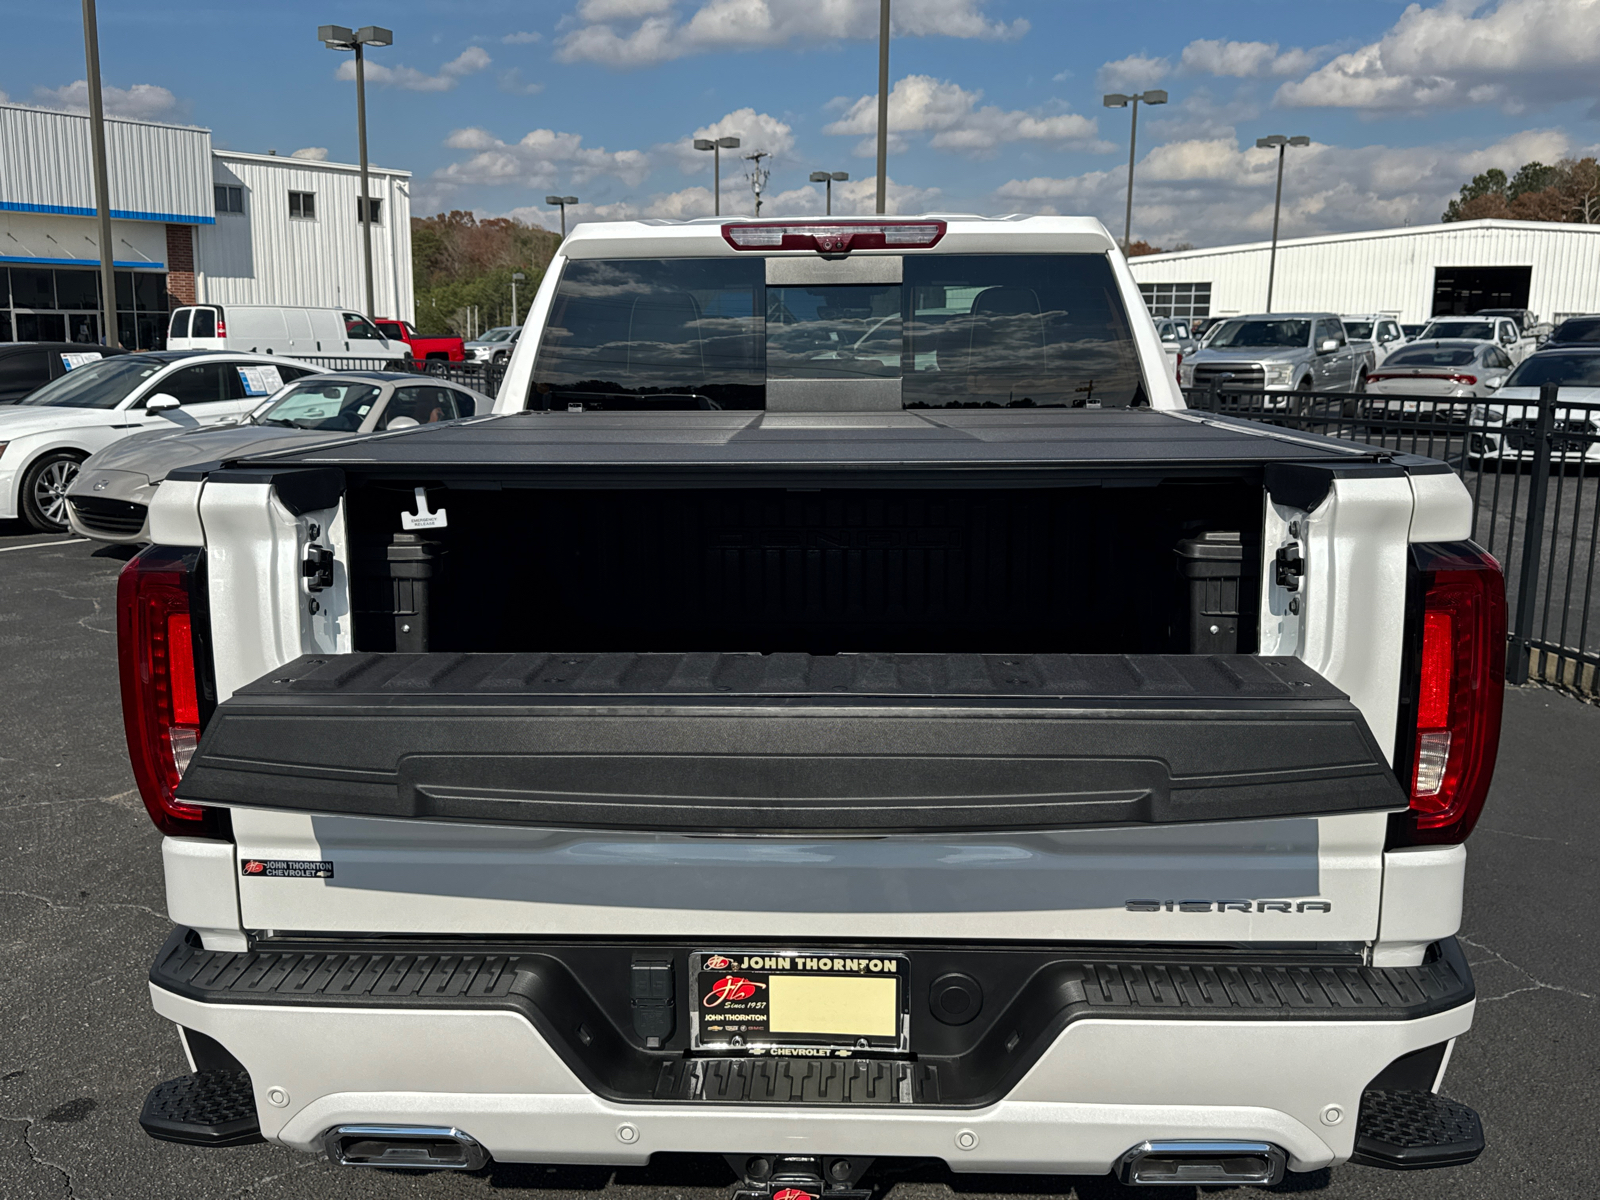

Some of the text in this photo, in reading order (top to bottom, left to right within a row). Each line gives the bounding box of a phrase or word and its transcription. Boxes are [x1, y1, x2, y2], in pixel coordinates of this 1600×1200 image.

[265, 861, 287, 869] JOHN
[288, 862, 332, 870] THORNTON
[1125, 899, 1332, 913] SIERRA
[741, 956, 791, 970] JOHN
[795, 957, 897, 972] THORNTON
[724, 1001, 767, 1009] Since 1957
[770, 1048, 832, 1057] CHEVROLET
